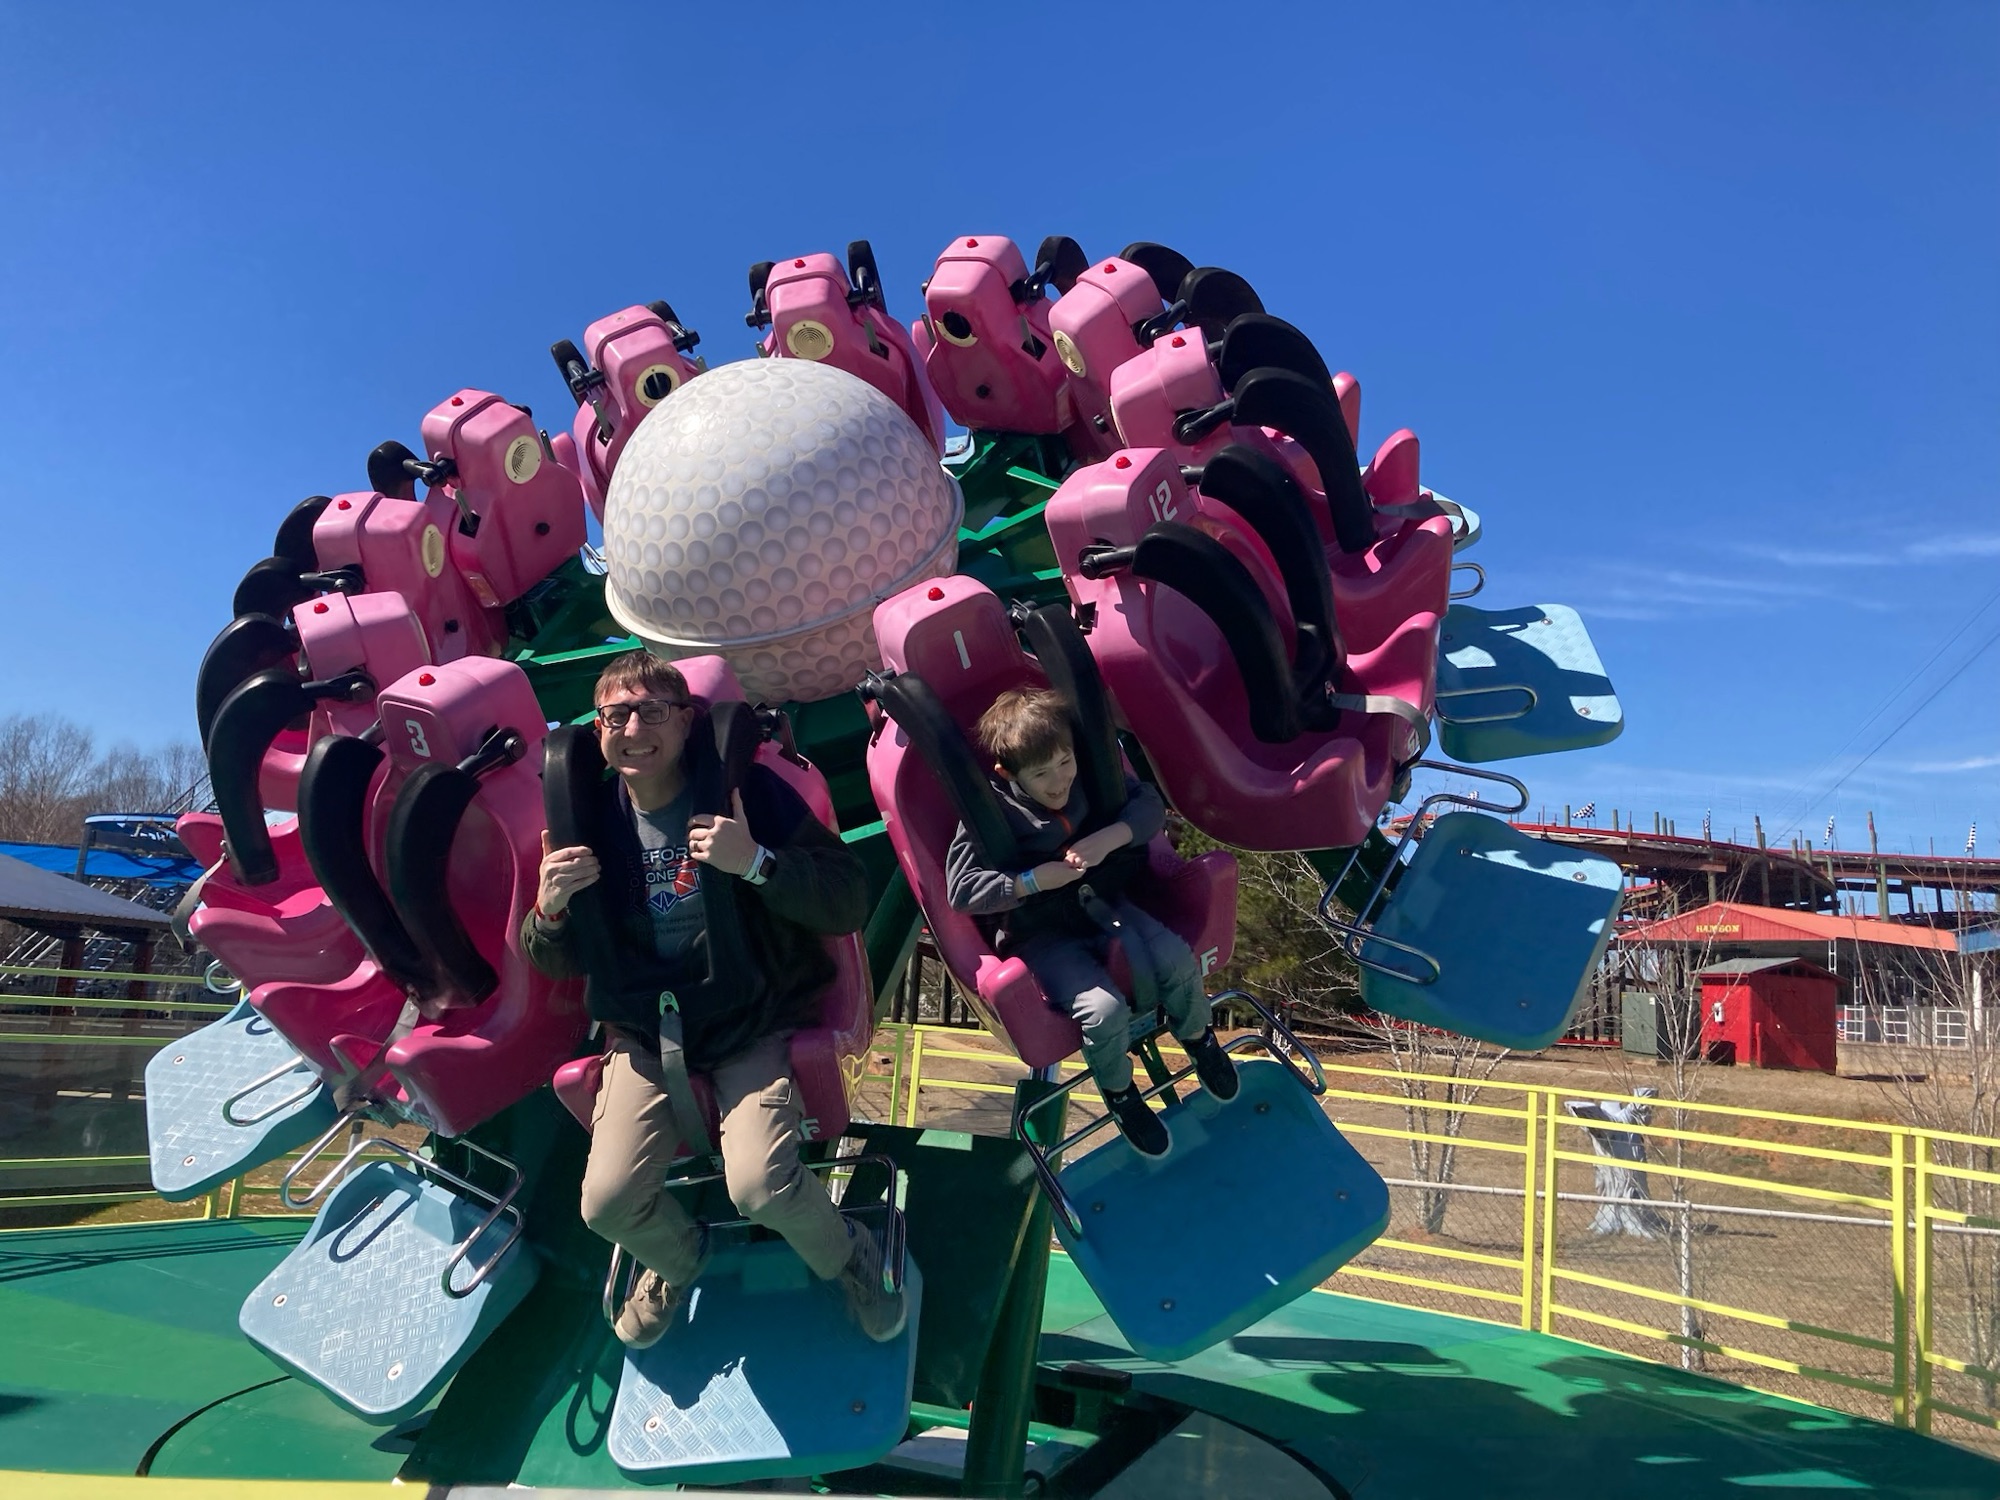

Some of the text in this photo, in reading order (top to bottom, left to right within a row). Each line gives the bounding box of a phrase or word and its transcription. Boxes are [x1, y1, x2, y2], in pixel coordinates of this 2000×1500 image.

[1148, 479, 1178, 522] 12
[953, 630, 972, 670] 1
[405, 719, 431, 757] 3
